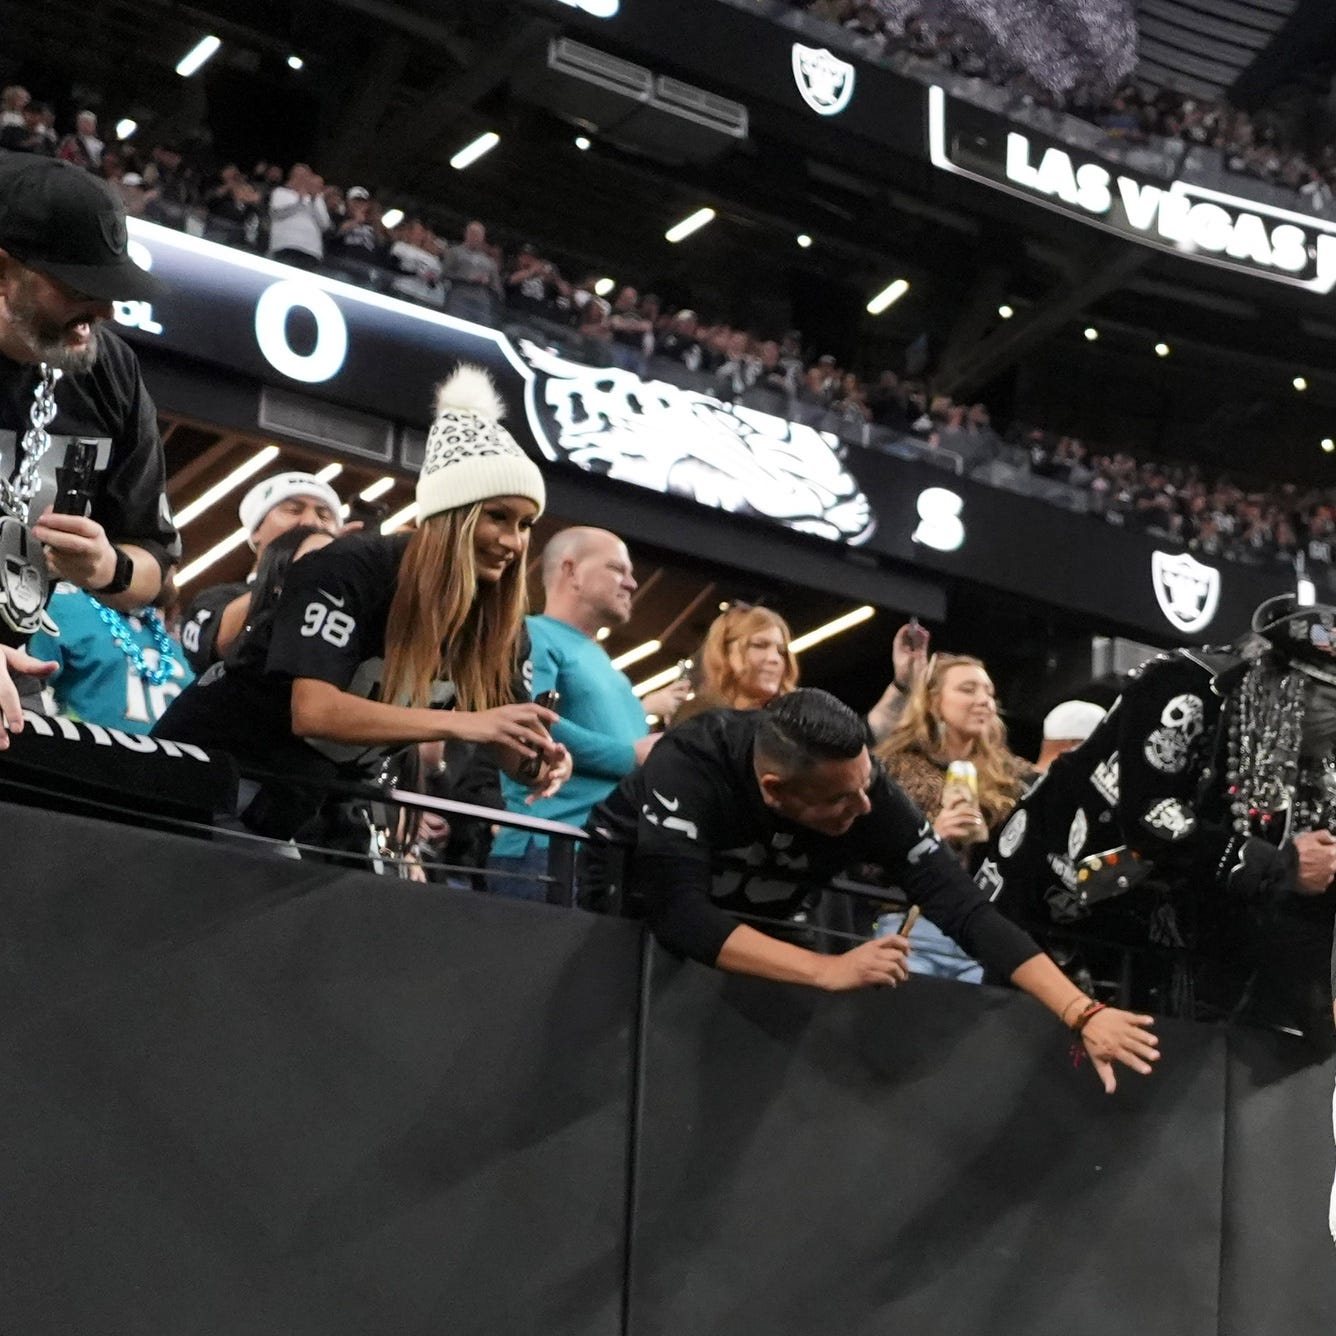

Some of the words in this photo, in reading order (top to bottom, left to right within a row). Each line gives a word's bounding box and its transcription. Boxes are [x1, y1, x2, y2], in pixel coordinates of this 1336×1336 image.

[1006, 131, 1112, 214] LAS
[1116, 175, 1308, 272] VEGAS
[300, 601, 357, 649] 98
